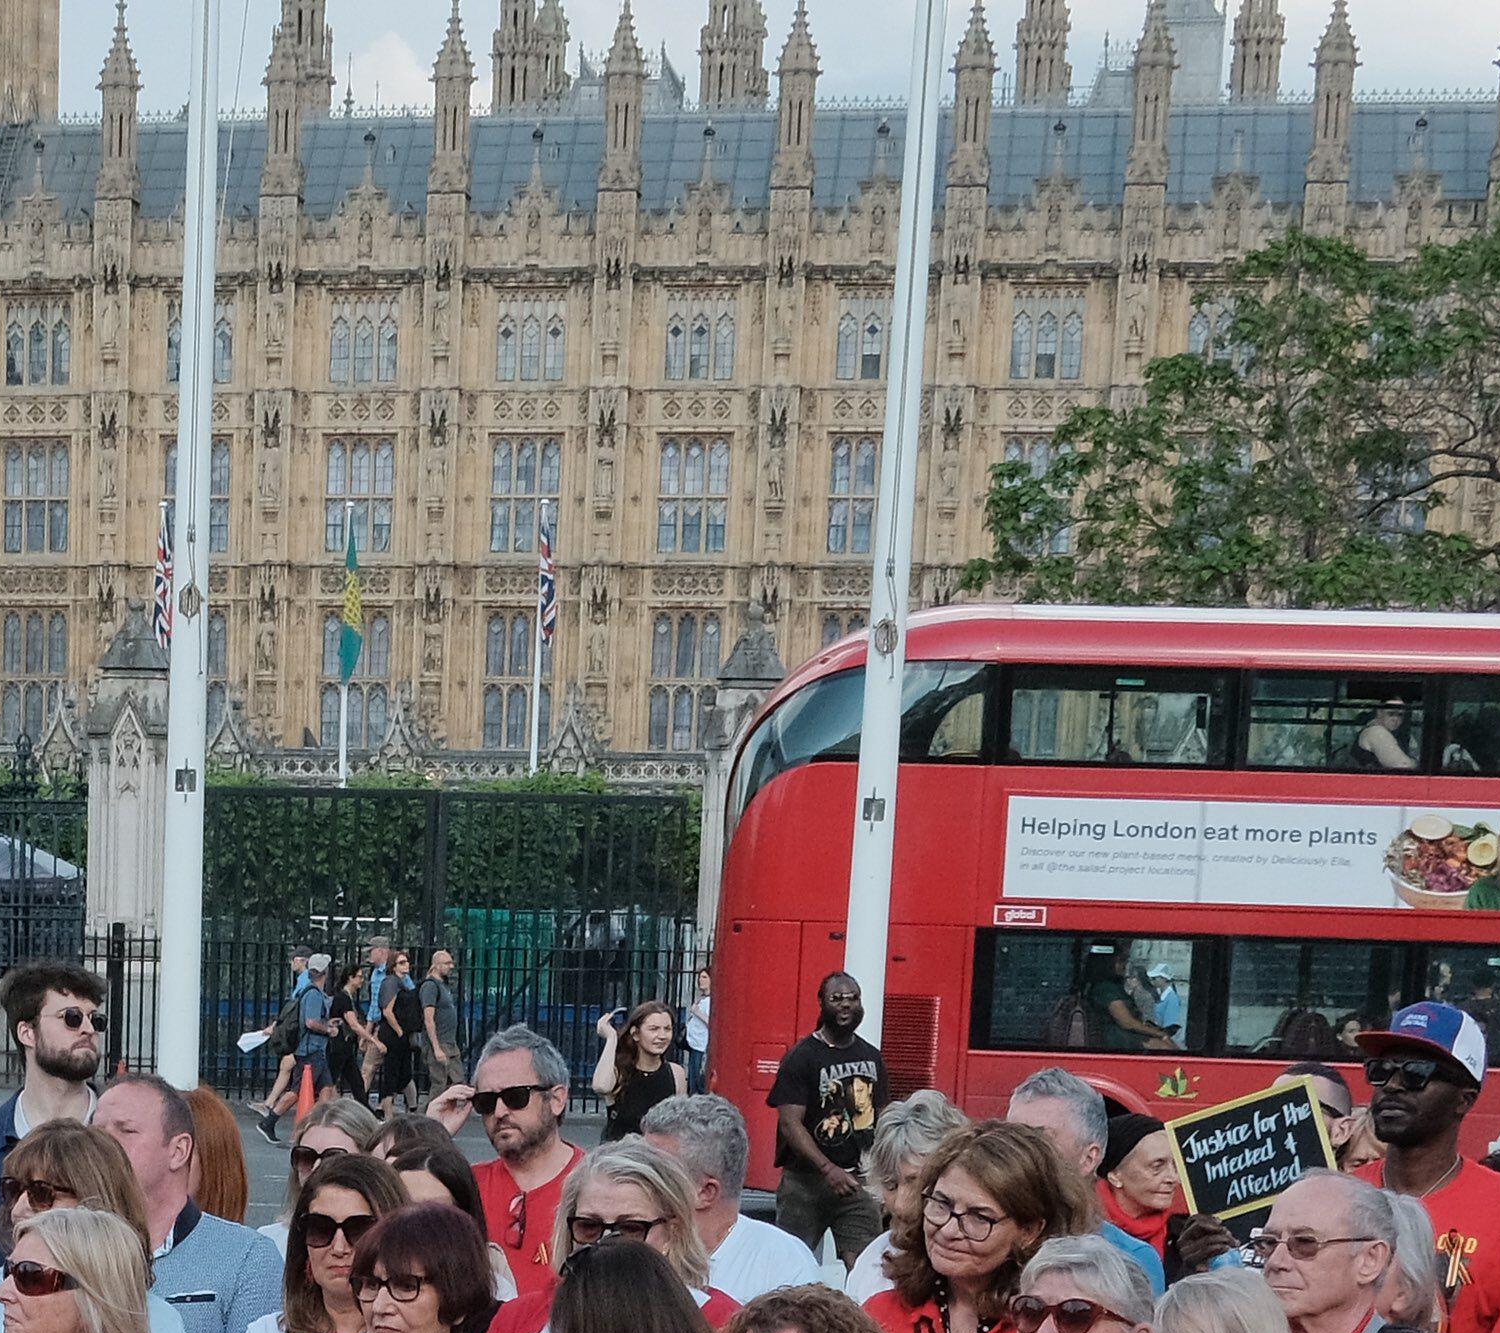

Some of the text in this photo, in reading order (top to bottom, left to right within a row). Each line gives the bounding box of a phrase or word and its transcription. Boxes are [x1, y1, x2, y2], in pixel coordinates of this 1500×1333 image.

[1020, 816, 1379, 848] Helping London eat more plants
[1020, 846, 1066, 858] Discover
[1068, 849, 1086, 859] our
[1088, 851, 1111, 859] new
[1212, 853, 1254, 865] created
[1256, 855, 1270, 867] by
[1271, 854, 1329, 868] Deliciously
[1108, 865, 1146, 877] project
[1004, 908, 1037, 922] global
[1181, 1098, 1313, 1165] Justice for the
[1205, 1138, 1276, 1184] Infected
[1226, 1155, 1302, 1206] Affected
